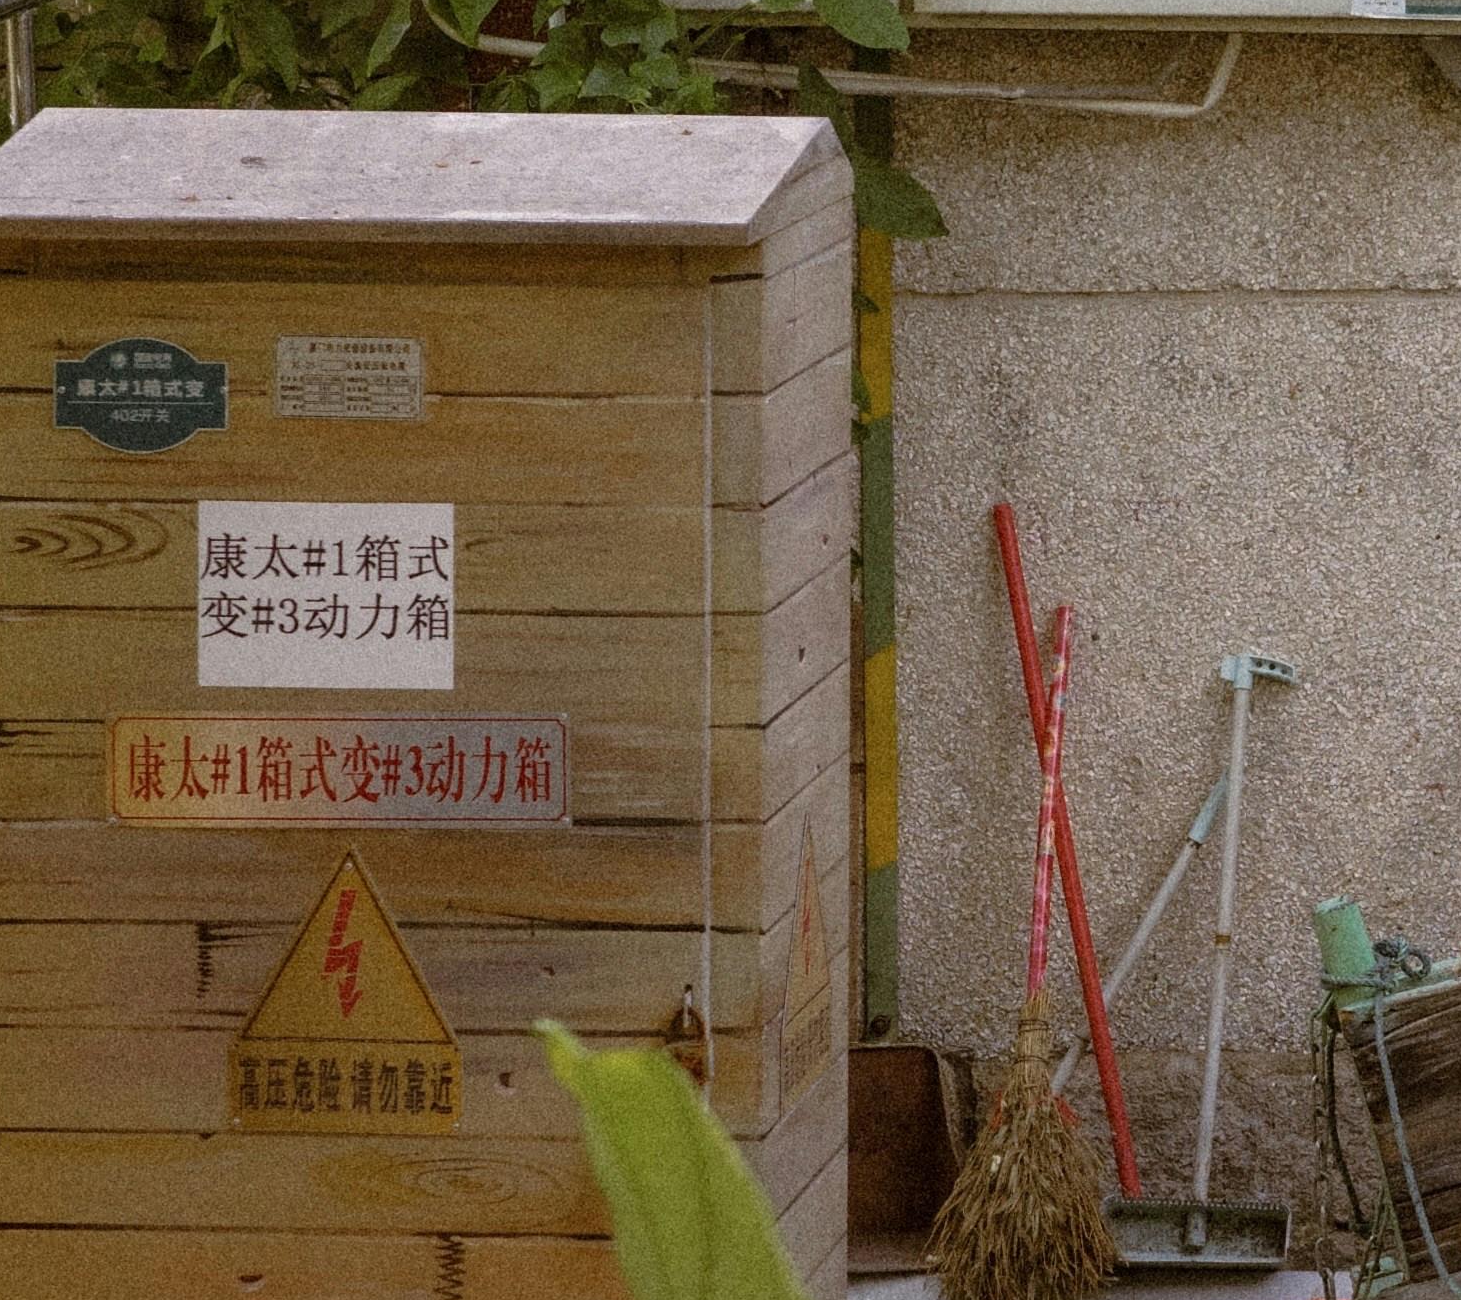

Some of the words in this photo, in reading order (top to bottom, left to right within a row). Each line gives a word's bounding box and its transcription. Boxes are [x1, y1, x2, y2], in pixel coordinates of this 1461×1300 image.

[111, 409, 170, 423] 402开关
[201, 533, 449, 581] 康太#1箱式
[201, 591, 449, 640] 变#3动力箱
[128, 734, 551, 803] 康太#1箱式变#3动力箱
